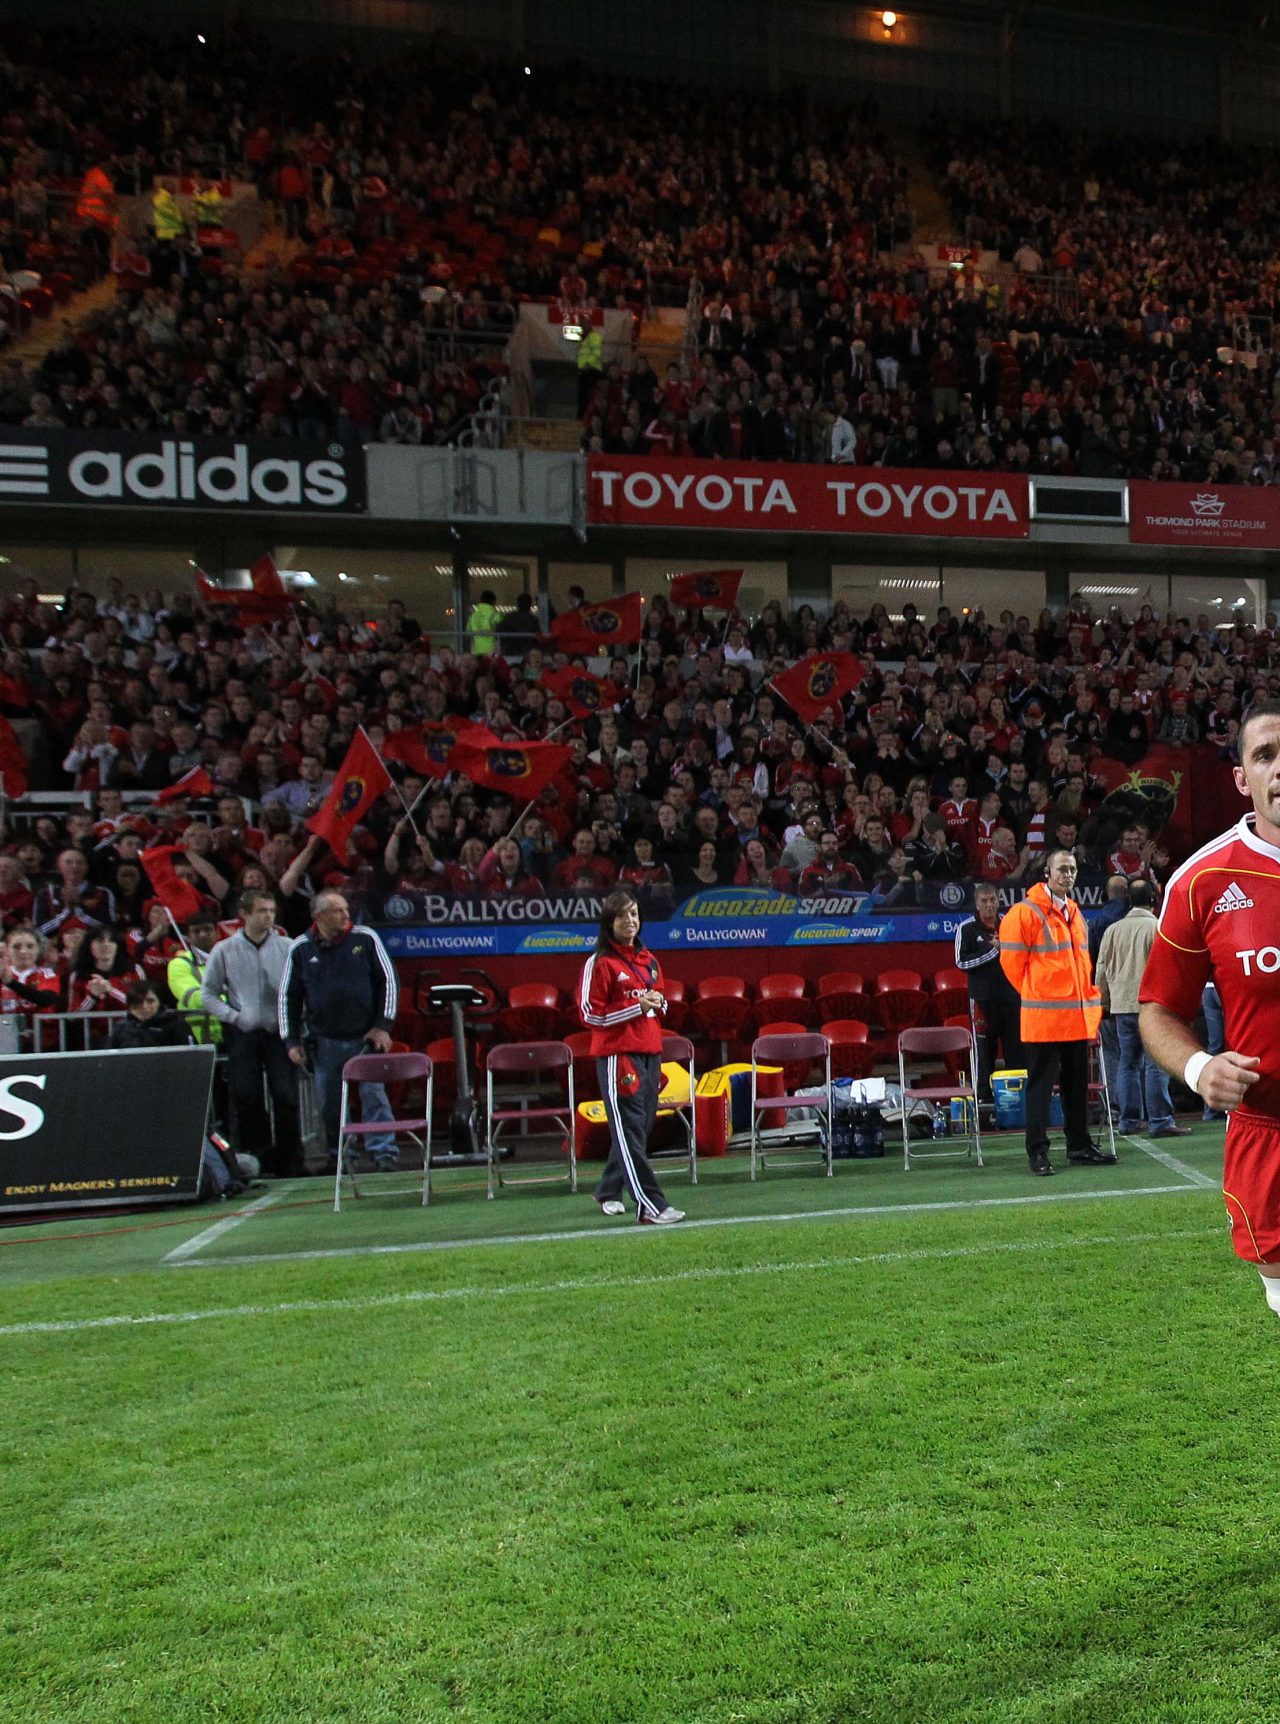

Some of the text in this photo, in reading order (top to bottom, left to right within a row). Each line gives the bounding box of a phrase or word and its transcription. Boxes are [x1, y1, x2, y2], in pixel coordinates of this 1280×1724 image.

[68, 441, 348, 505] adidas
[591, 470, 798, 514] TOYOTA
[826, 480, 1018, 523] TOYOTA
[1145, 515, 1266, 530] THOMOND PARK STADIUM
[424, 895, 606, 923] BALLYGOWAN
[683, 895, 868, 918] Lucozade SPORT
[1214, 897, 1254, 914] adidas
[406, 934, 494, 949] BALLYGOWAN
[686, 927, 767, 941] BALLYGOWAN
[0, 1074, 47, 1141] S
[5, 1175, 181, 1196] ENJOY MAGNERS SENSIBLY
